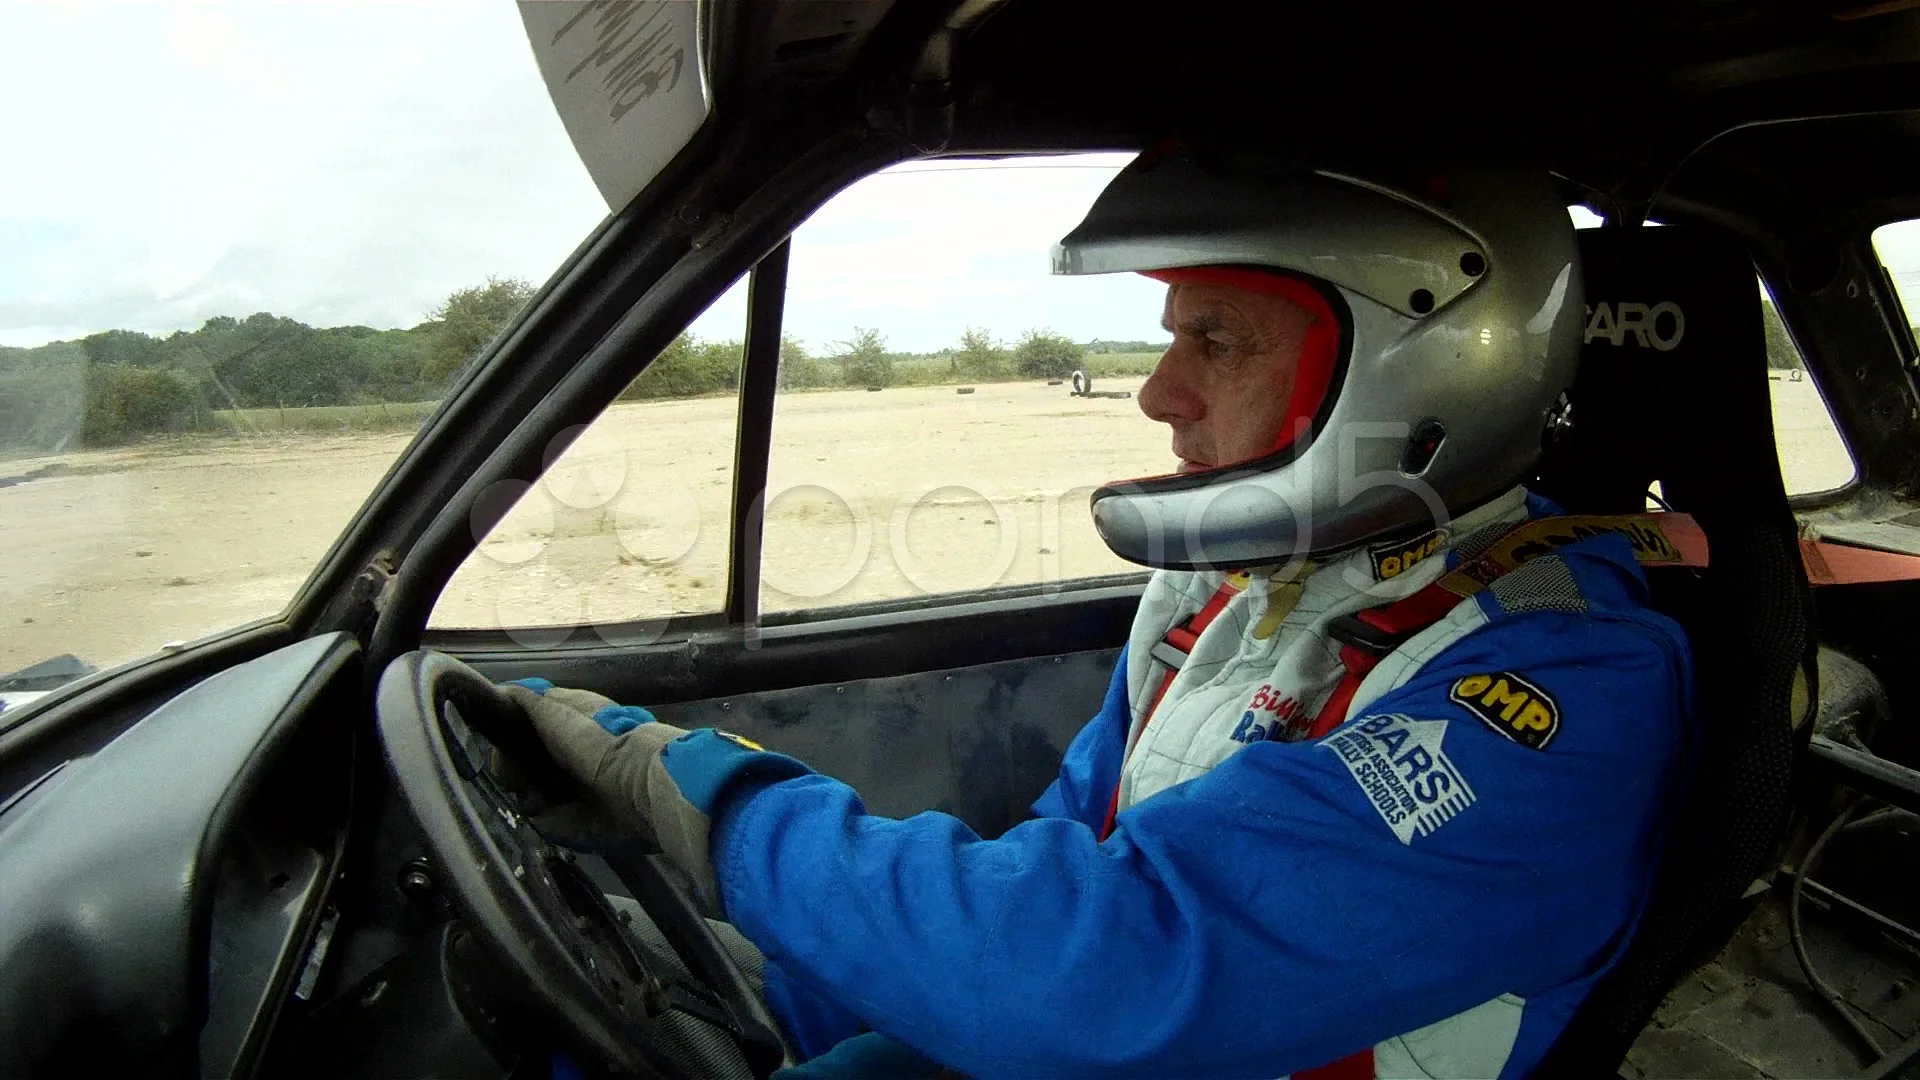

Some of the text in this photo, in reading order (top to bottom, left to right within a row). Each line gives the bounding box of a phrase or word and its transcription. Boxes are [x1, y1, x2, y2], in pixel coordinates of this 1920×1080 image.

[1584, 301, 1685, 351] ARO
[1380, 534, 1446, 577] OMP
[1457, 674, 1551, 732] OMP
[1361, 715, 1450, 804] BARS
[1369, 751, 1420, 815] ASSOCIATION
[1355, 762, 1408, 826] SCHOOLS
